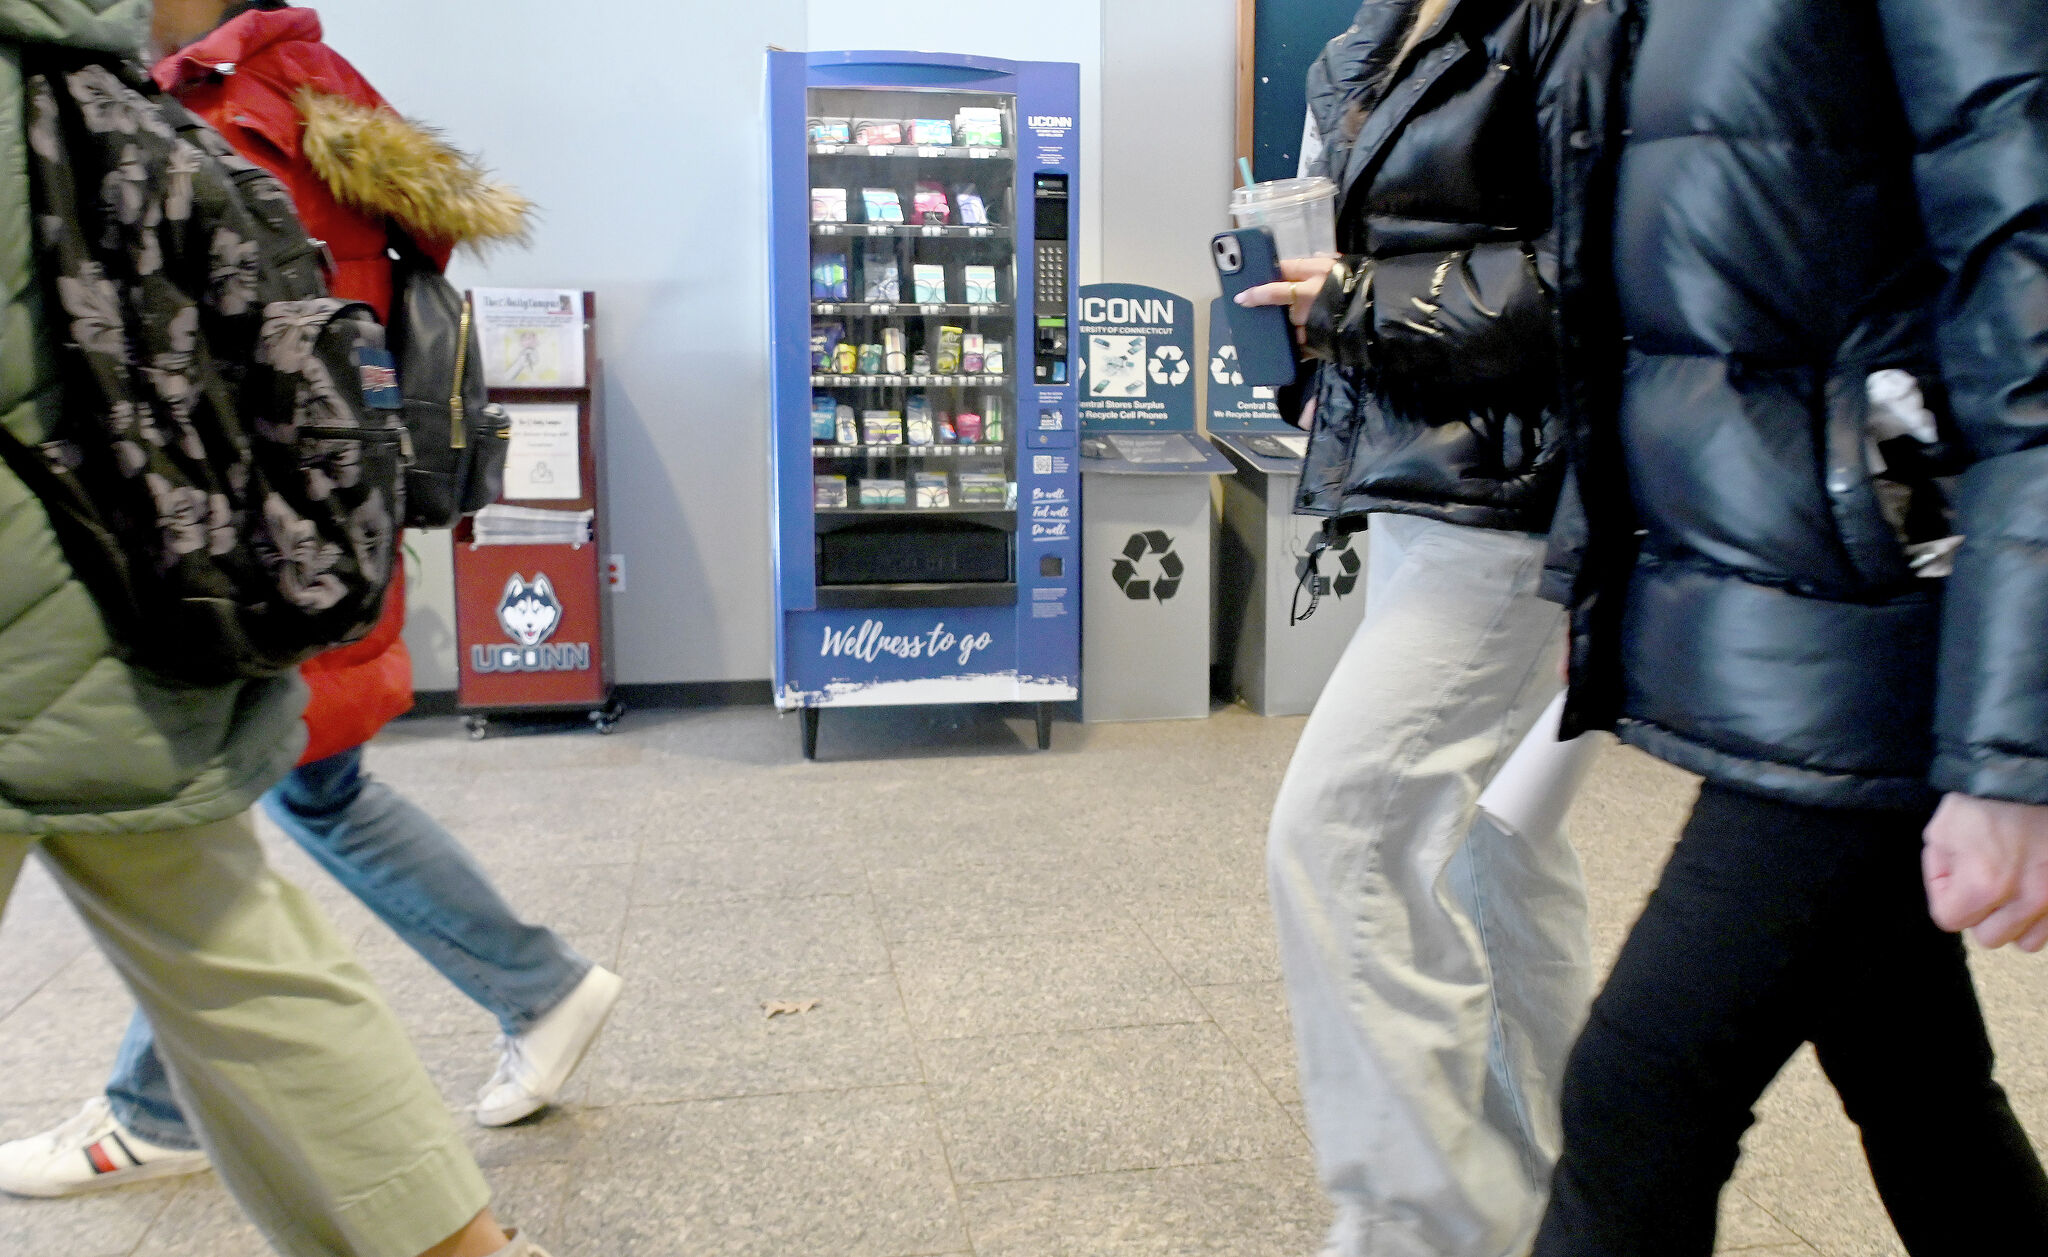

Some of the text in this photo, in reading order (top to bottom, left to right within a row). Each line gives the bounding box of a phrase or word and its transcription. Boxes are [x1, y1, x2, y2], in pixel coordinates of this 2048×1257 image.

[1028, 115, 1072, 128] UCONN
[1079, 297, 1174, 324] CONN
[1080, 326, 1106, 334] ERSITY
[1119, 327, 1173, 335] CONNECTICUT
[1080, 400, 1165, 411] entral Stores Surplus
[1237, 401, 1266, 410] Central
[1085, 410, 1119, 420] Recycle
[1120, 411, 1136, 419] Cell
[1137, 411, 1168, 420] Phones
[1213, 410, 1224, 418] We
[1225, 410, 1252, 419] Recycle
[1032, 488, 1044, 499] Be
[820, 619, 993, 666] Wellness to go
[471, 643, 590, 673] UCONN
